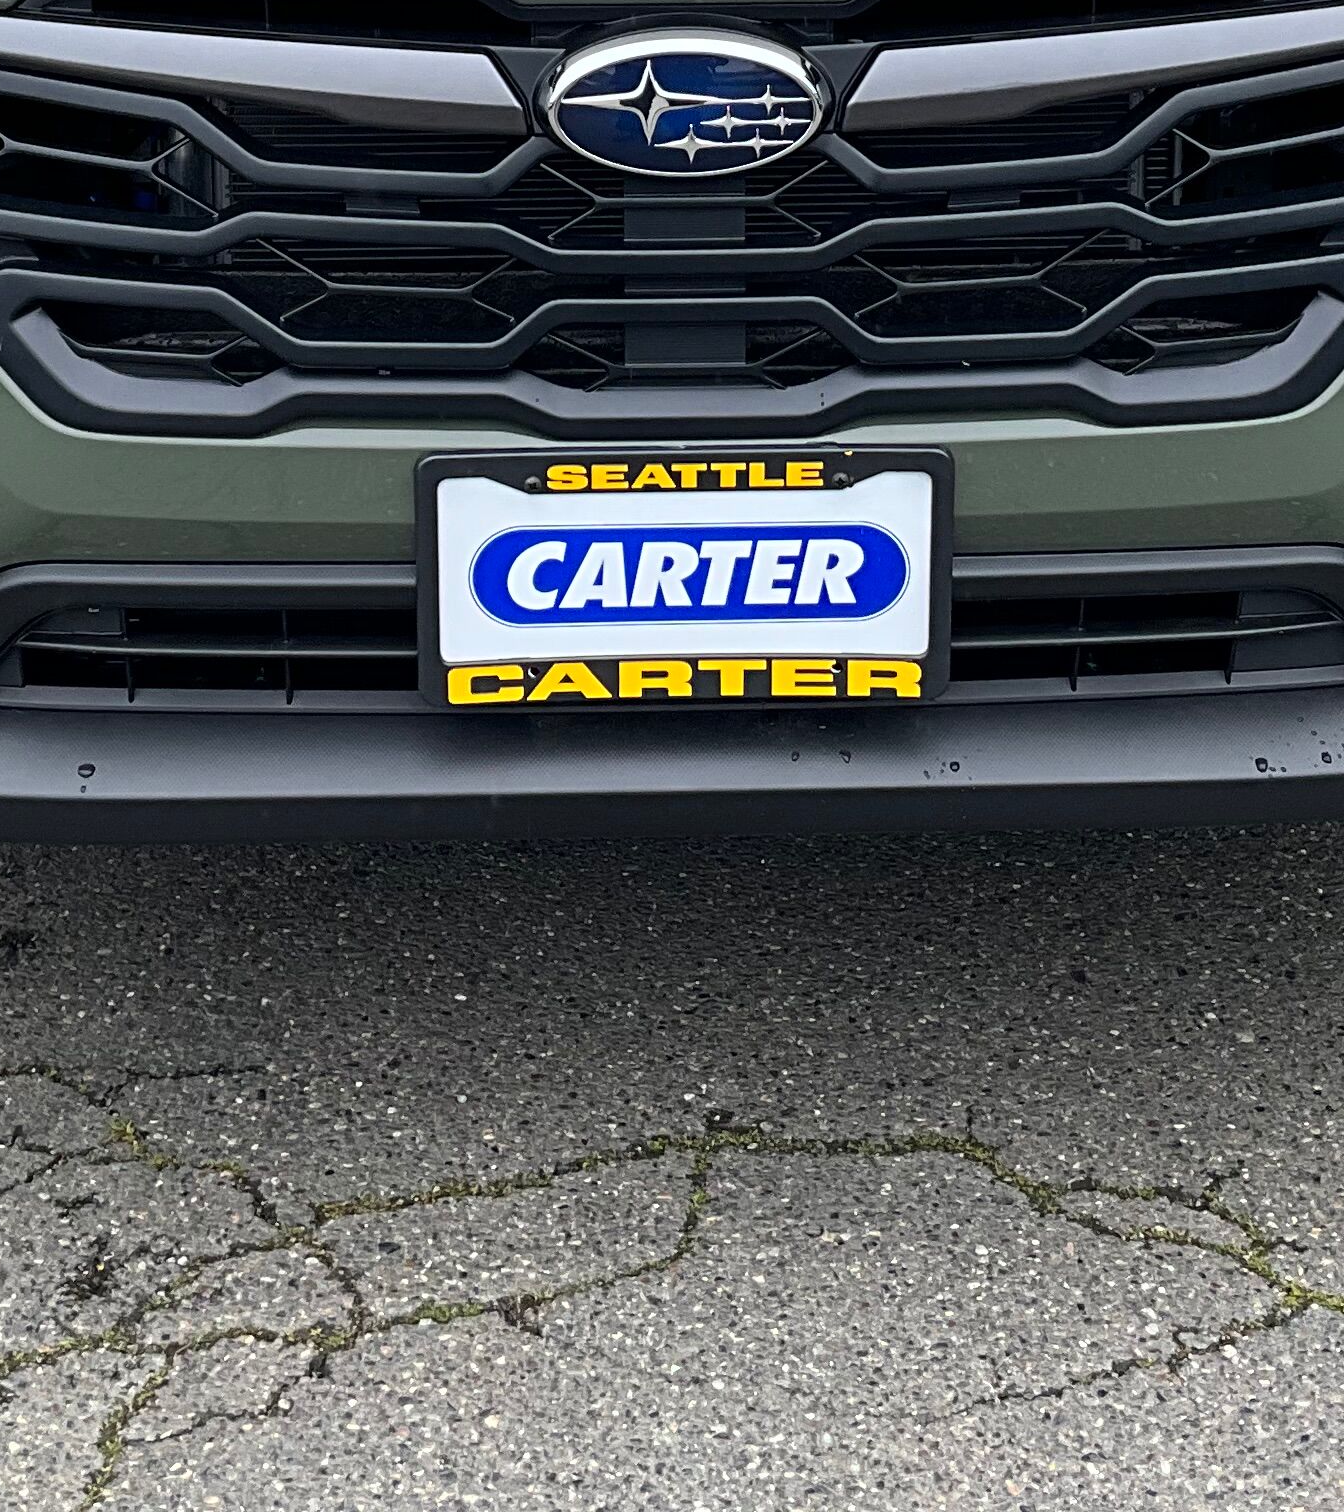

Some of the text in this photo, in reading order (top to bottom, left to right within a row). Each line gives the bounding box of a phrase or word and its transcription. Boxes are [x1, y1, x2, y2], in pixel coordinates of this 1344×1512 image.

[546, 461, 824, 491] SEATTLE
[506, 538, 865, 610] CARTER
[447, 659, 922, 705] CARTER
